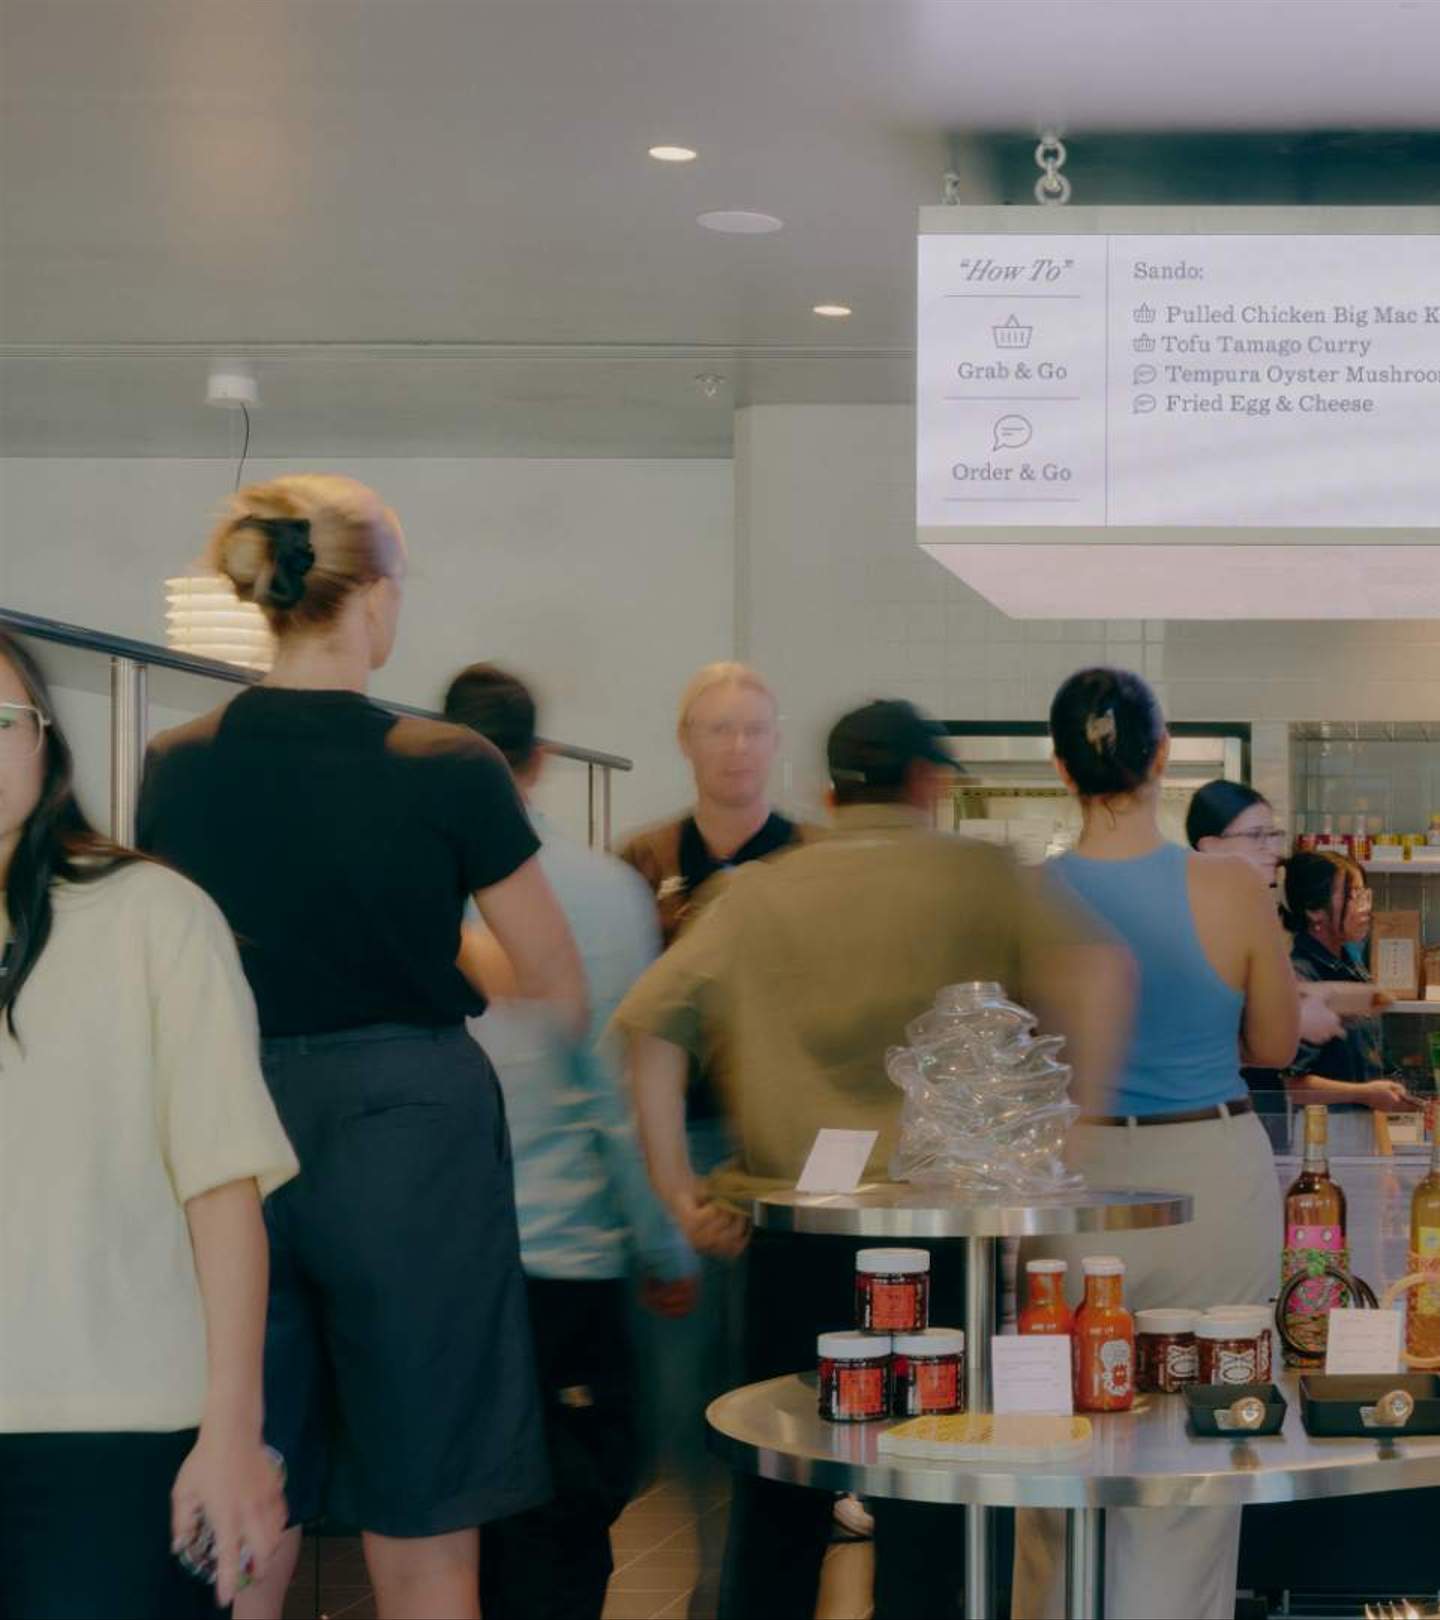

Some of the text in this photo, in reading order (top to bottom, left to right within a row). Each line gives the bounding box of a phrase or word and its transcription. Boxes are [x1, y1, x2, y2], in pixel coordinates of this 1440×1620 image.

[1133, 260, 1203, 280] Sando:
[1165, 305, 1236, 324] Pulled
[1241, 304, 1327, 324] Chicken
[1333, 305, 1368, 329] Big
[1374, 305, 1419, 324] Mac
[1161, 335, 1211, 354] Tofu
[1216, 335, 1302, 359] Tamago
[1307, 336, 1372, 360] Curry
[957, 360, 1068, 381] Grab & Go
[1164, 365, 1260, 387] Tempura
[1266, 365, 1340, 388] Oyster
[1166, 394, 1223, 413] Fried
[1230, 395, 1271, 418] Egg
[1276, 395, 1293, 413] &
[1298, 394, 1374, 413] Cheese
[952, 462, 1072, 482] Order & Go
